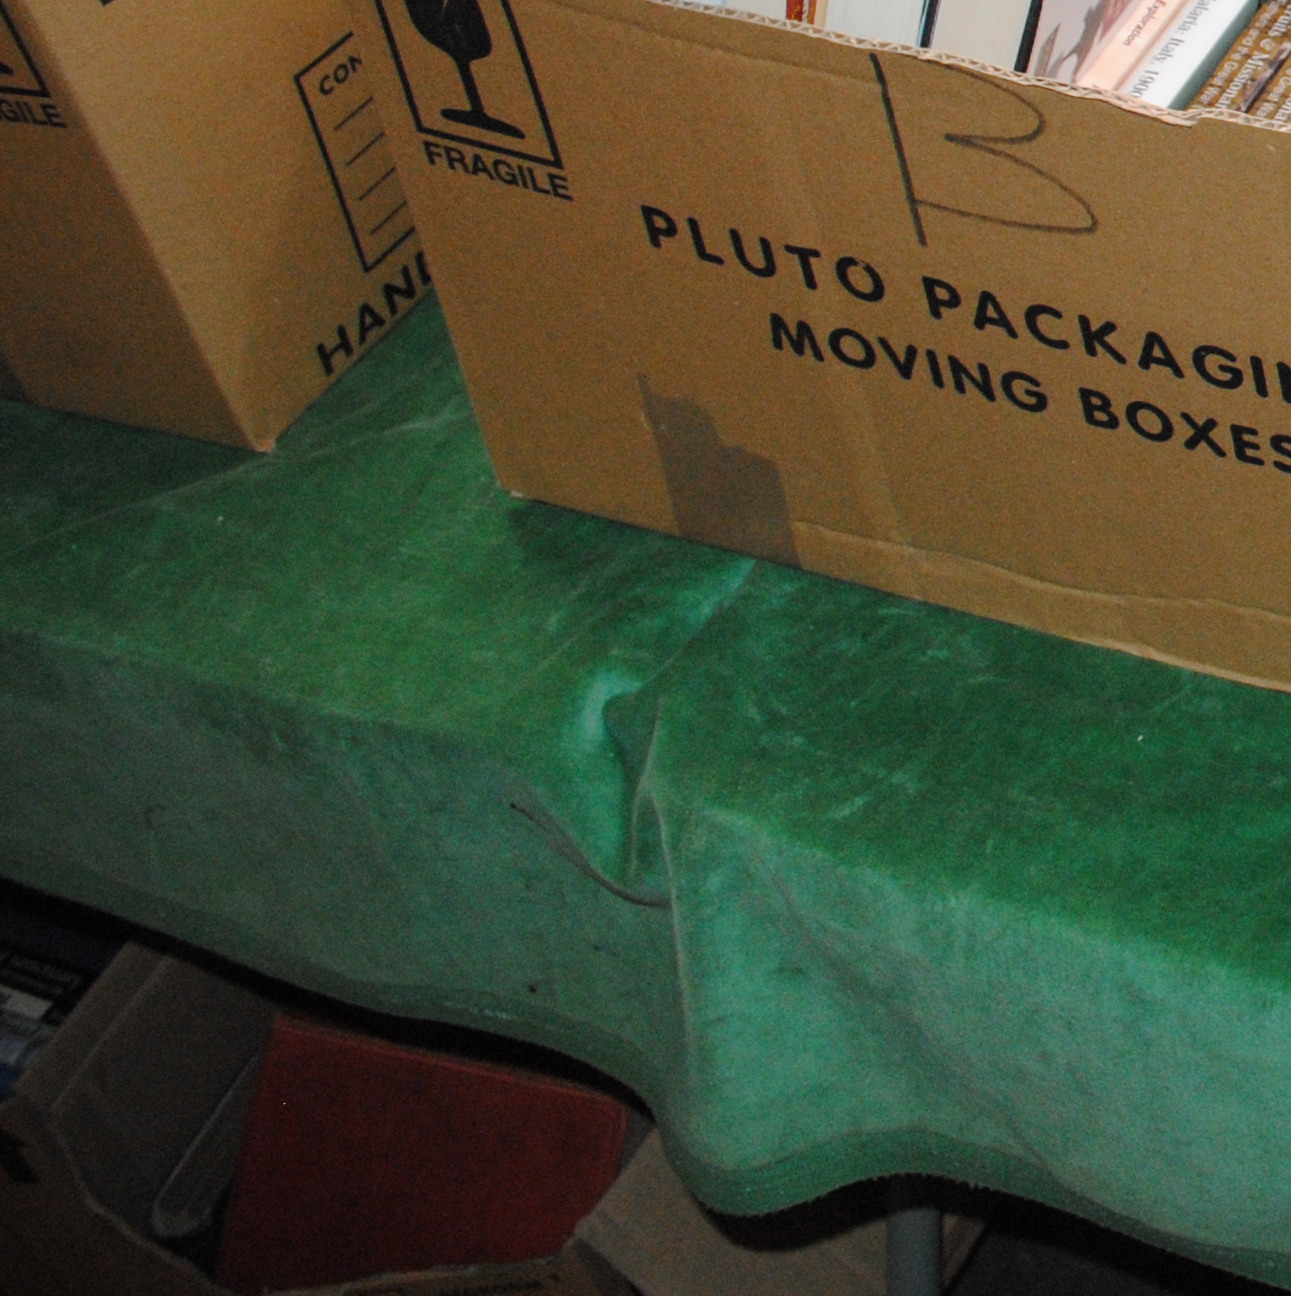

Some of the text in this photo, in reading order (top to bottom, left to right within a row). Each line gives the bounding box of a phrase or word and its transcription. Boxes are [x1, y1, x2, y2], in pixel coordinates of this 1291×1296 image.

[421, 138, 577, 203] FRAGILE
[640, 203, 886, 304] PLUTO
[768, 311, 1050, 414] MOVING
